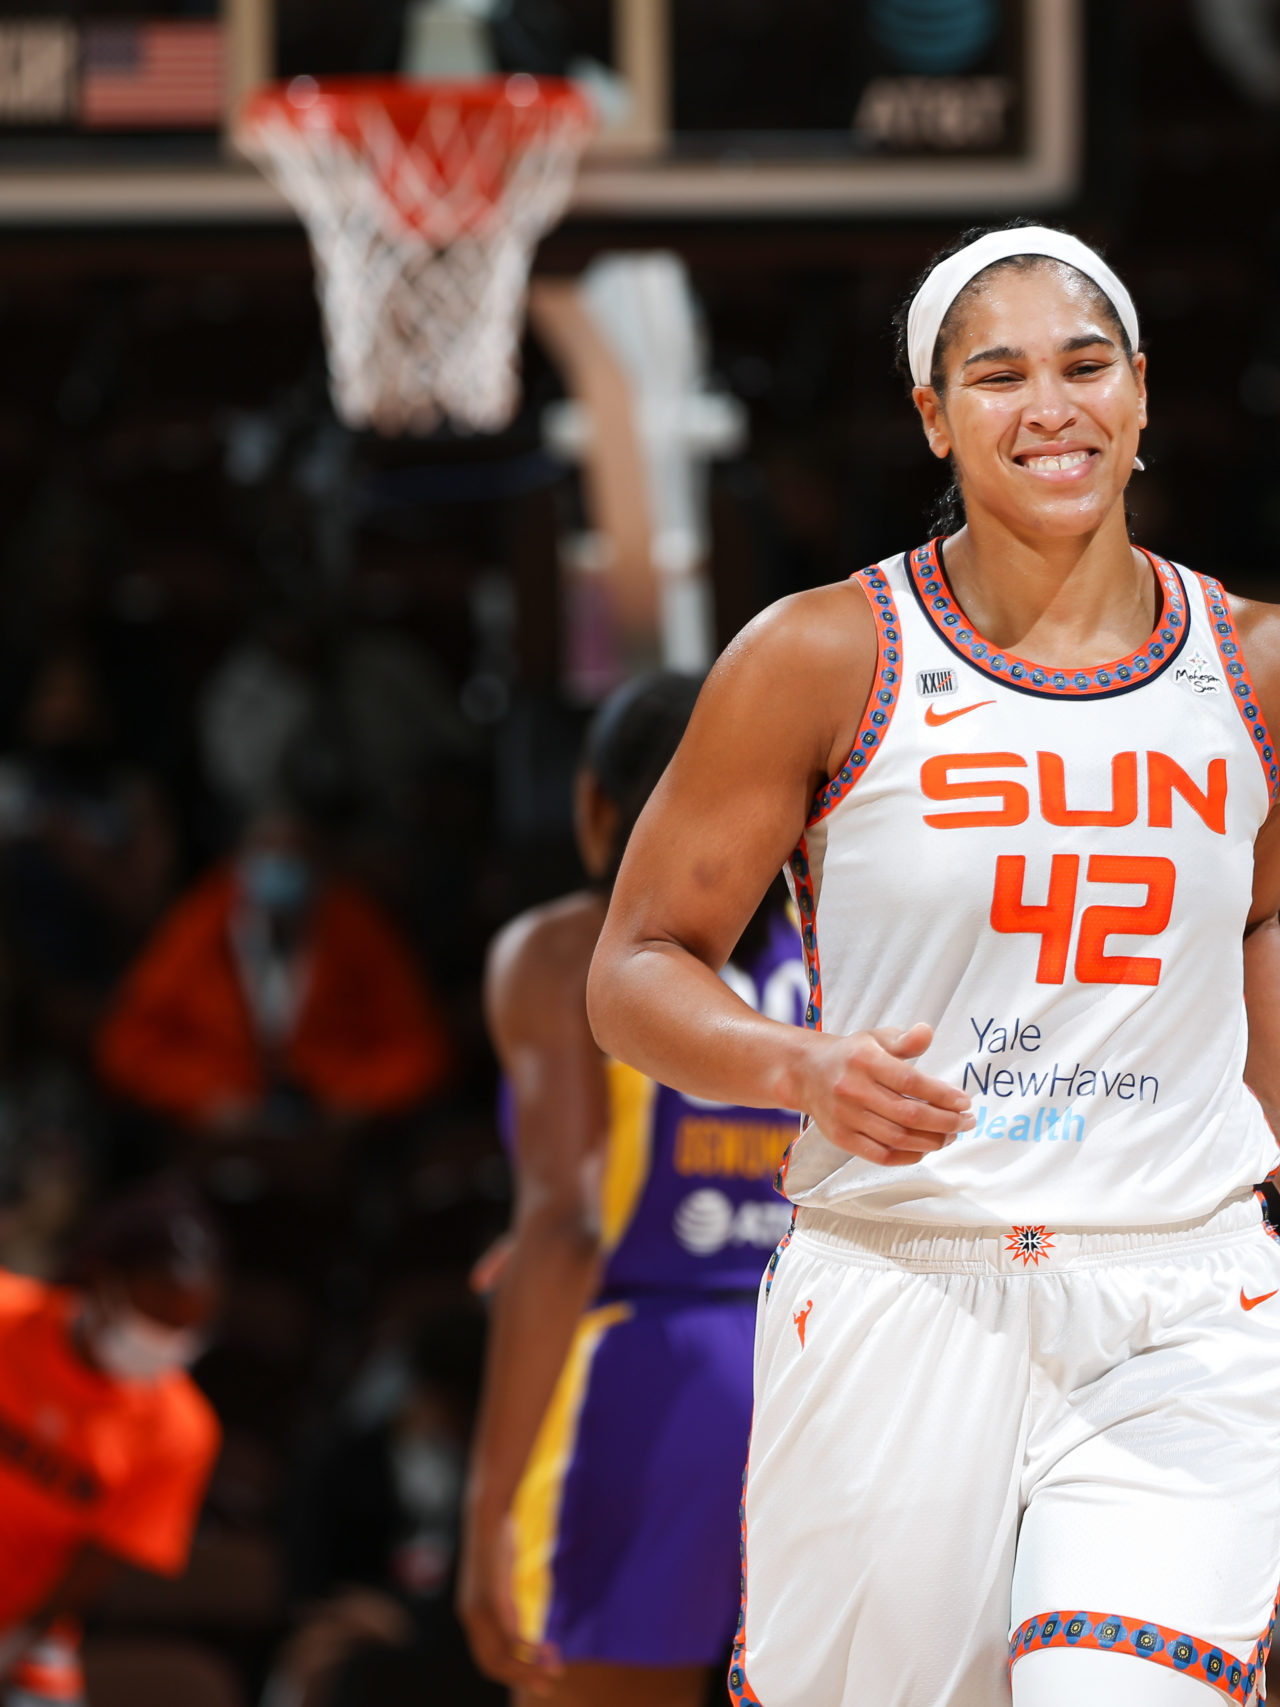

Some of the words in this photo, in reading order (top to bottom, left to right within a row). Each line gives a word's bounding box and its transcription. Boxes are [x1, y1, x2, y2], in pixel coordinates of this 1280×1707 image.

[920, 750, 1227, 835] SUN
[990, 854, 1176, 986] 42
[970, 1017, 1042, 1053] Yale
[962, 1062, 1159, 1104] NewHaven
